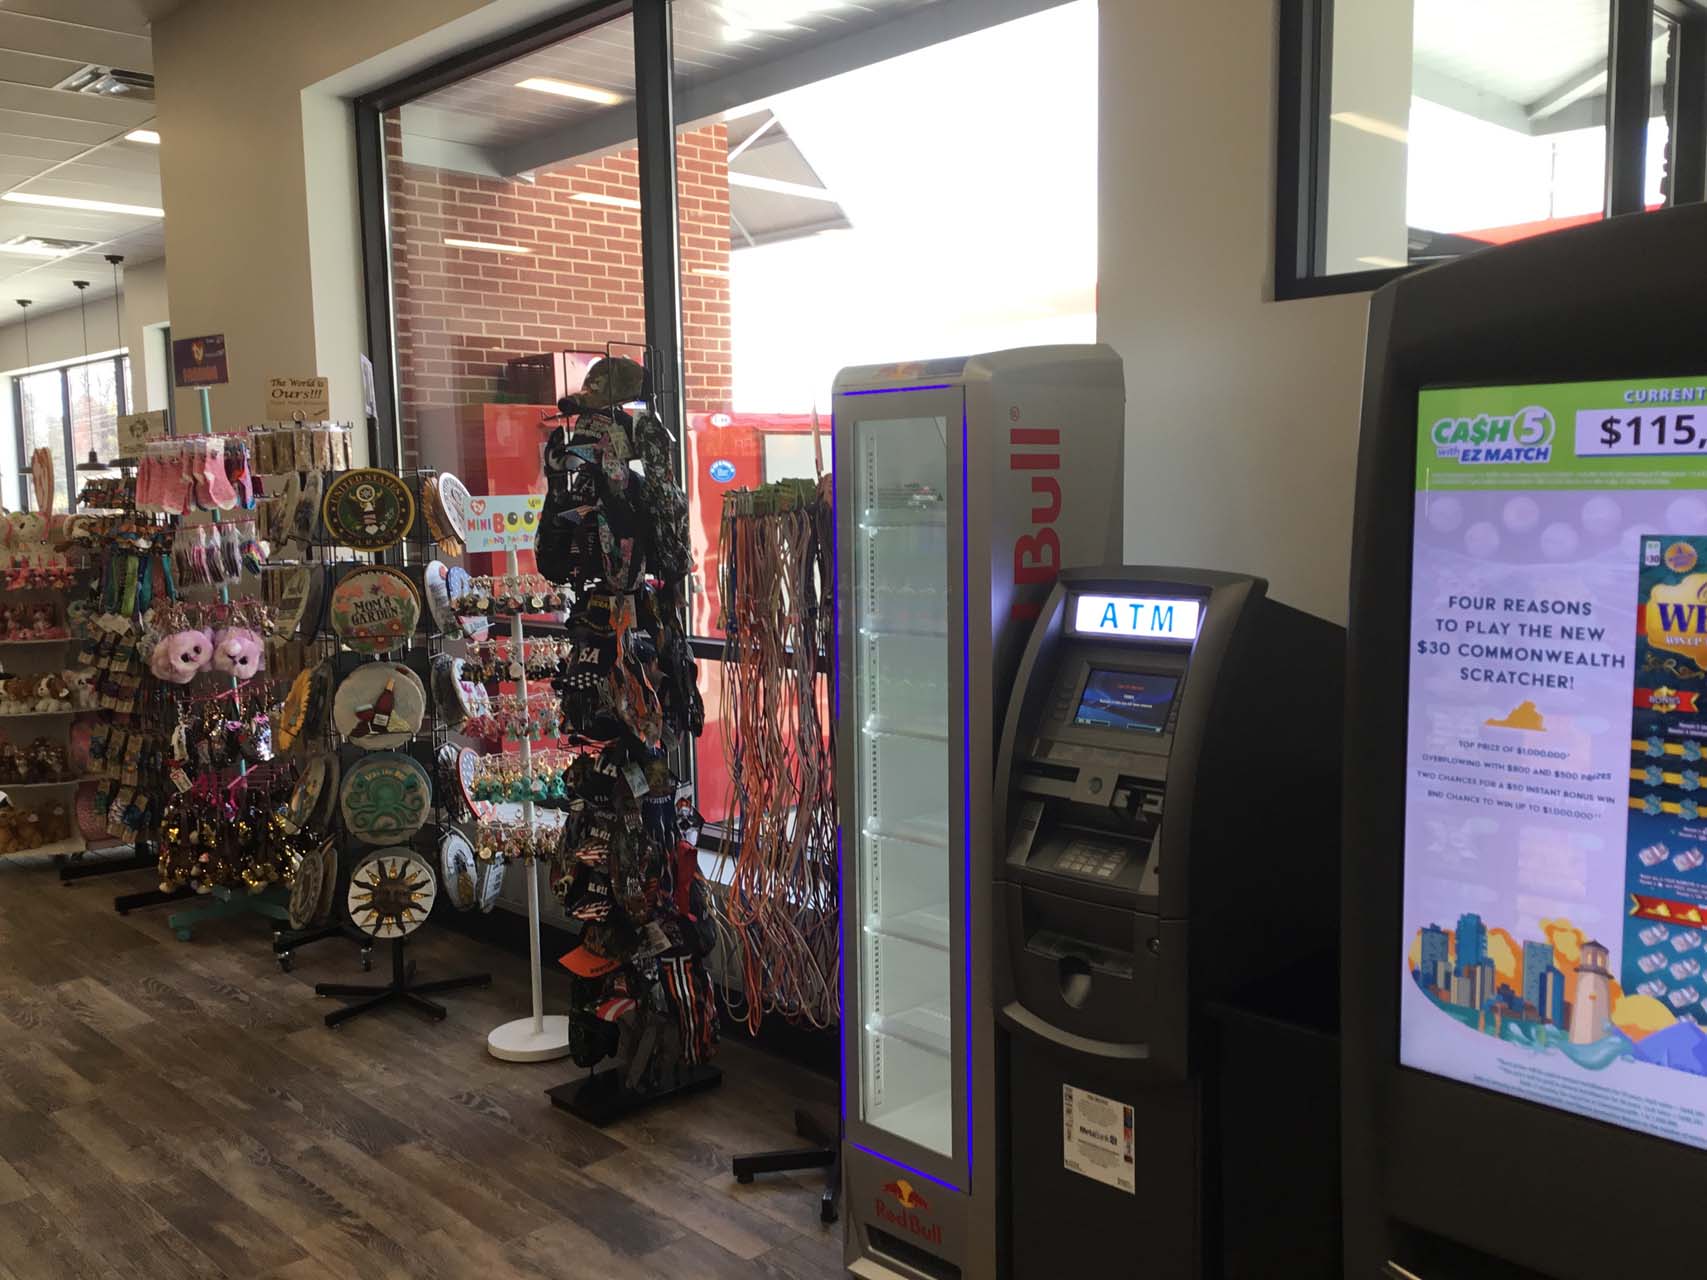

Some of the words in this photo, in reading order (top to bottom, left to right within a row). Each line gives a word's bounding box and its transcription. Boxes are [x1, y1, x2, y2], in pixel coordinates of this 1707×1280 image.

[271, 388, 322, 400] Ours!!!
[1624, 387, 1707, 404] CURRENT
[1519, 408, 1547, 446] 5
[1601, 415, 1707, 449] $115,
[1438, 448, 1459, 458] with
[1461, 449, 1482, 462] EZ
[1485, 448, 1549, 461] MATCH
[1010, 428, 1062, 585] Bull
[467, 519, 491, 531] MINI
[351, 606, 399, 626] GARDEN
[353, 597, 392, 615] MOM'S
[1100, 602, 1175, 633] ATM
[1449, 596, 1496, 611] FOUR
[1503, 598, 1593, 616] REASONS
[1436, 618, 1458, 632] TO
[1465, 620, 1510, 636] PLAY
[1518, 623, 1553, 639] THE
[1560, 625, 1606, 642] NEW
[1417, 639, 1451, 655] $30
[1458, 643, 1626, 669] COMMONWEALTH
[1460, 667, 1575, 690] SCRATCHER!
[1458, 740, 1475, 749] TOP
[1477, 742, 1500, 752] PRIZE
[1502, 745, 1513, 753] OF
[1422, 753, 1481, 768] OVERFLOWING
[1484, 762, 1505, 770] WITH
[1532, 768, 1552, 776] AND
[1417, 770, 1436, 779] TWO
[1438, 774, 1477, 785] CHANCES
[1480, 779, 1496, 788] FOR
[1526, 785, 1561, 796] INSTANT
[1563, 791, 1594, 801] BONUS
[1597, 795, 1615, 804] WIN
[1446, 792, 1480, 804] CHANCE
[1483, 797, 1494, 806] TO
[1497, 800, 1513, 808] WIN
[1515, 802, 1526, 810] UP
[1529, 804, 1540, 812] TO
[875, 1198, 908, 1229] Red
[909, 1214, 942, 1247] Bull
